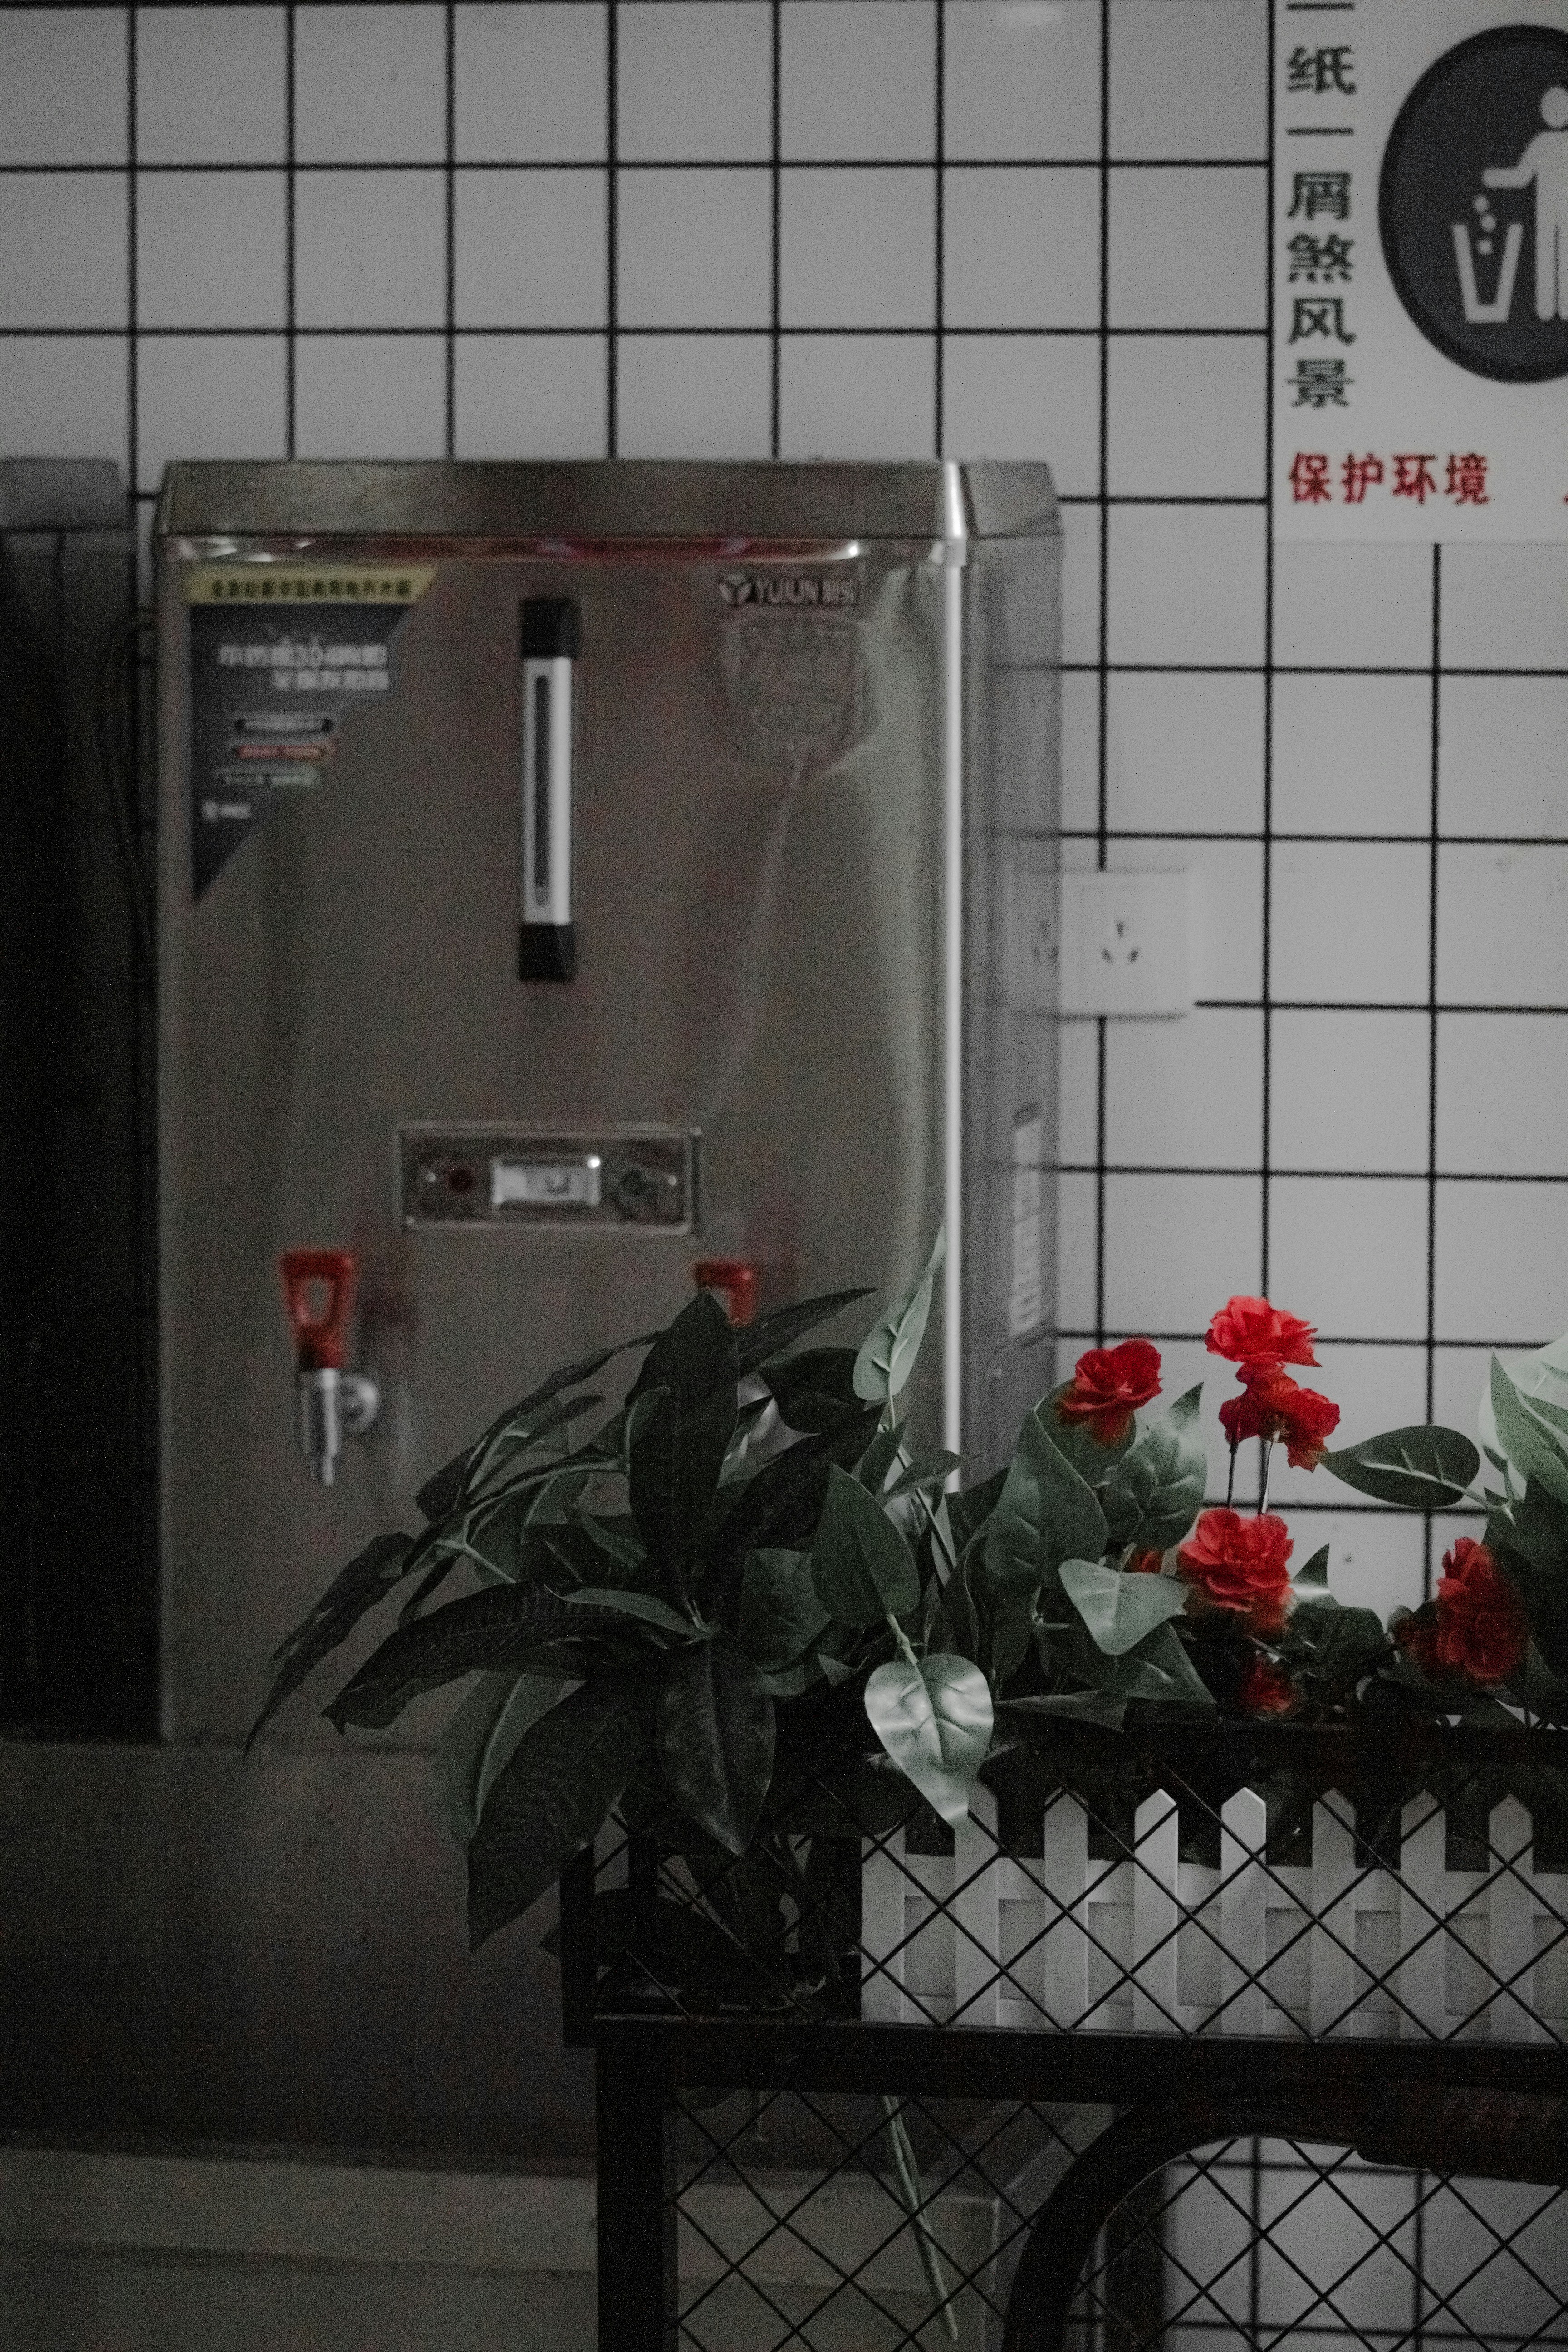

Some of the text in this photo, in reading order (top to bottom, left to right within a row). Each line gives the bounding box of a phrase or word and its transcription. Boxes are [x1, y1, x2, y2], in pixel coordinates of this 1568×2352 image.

[1285, 2, 1357, 408] 一纸一屑煞风景
[1289, 452, 1490, 505] 保护环境
